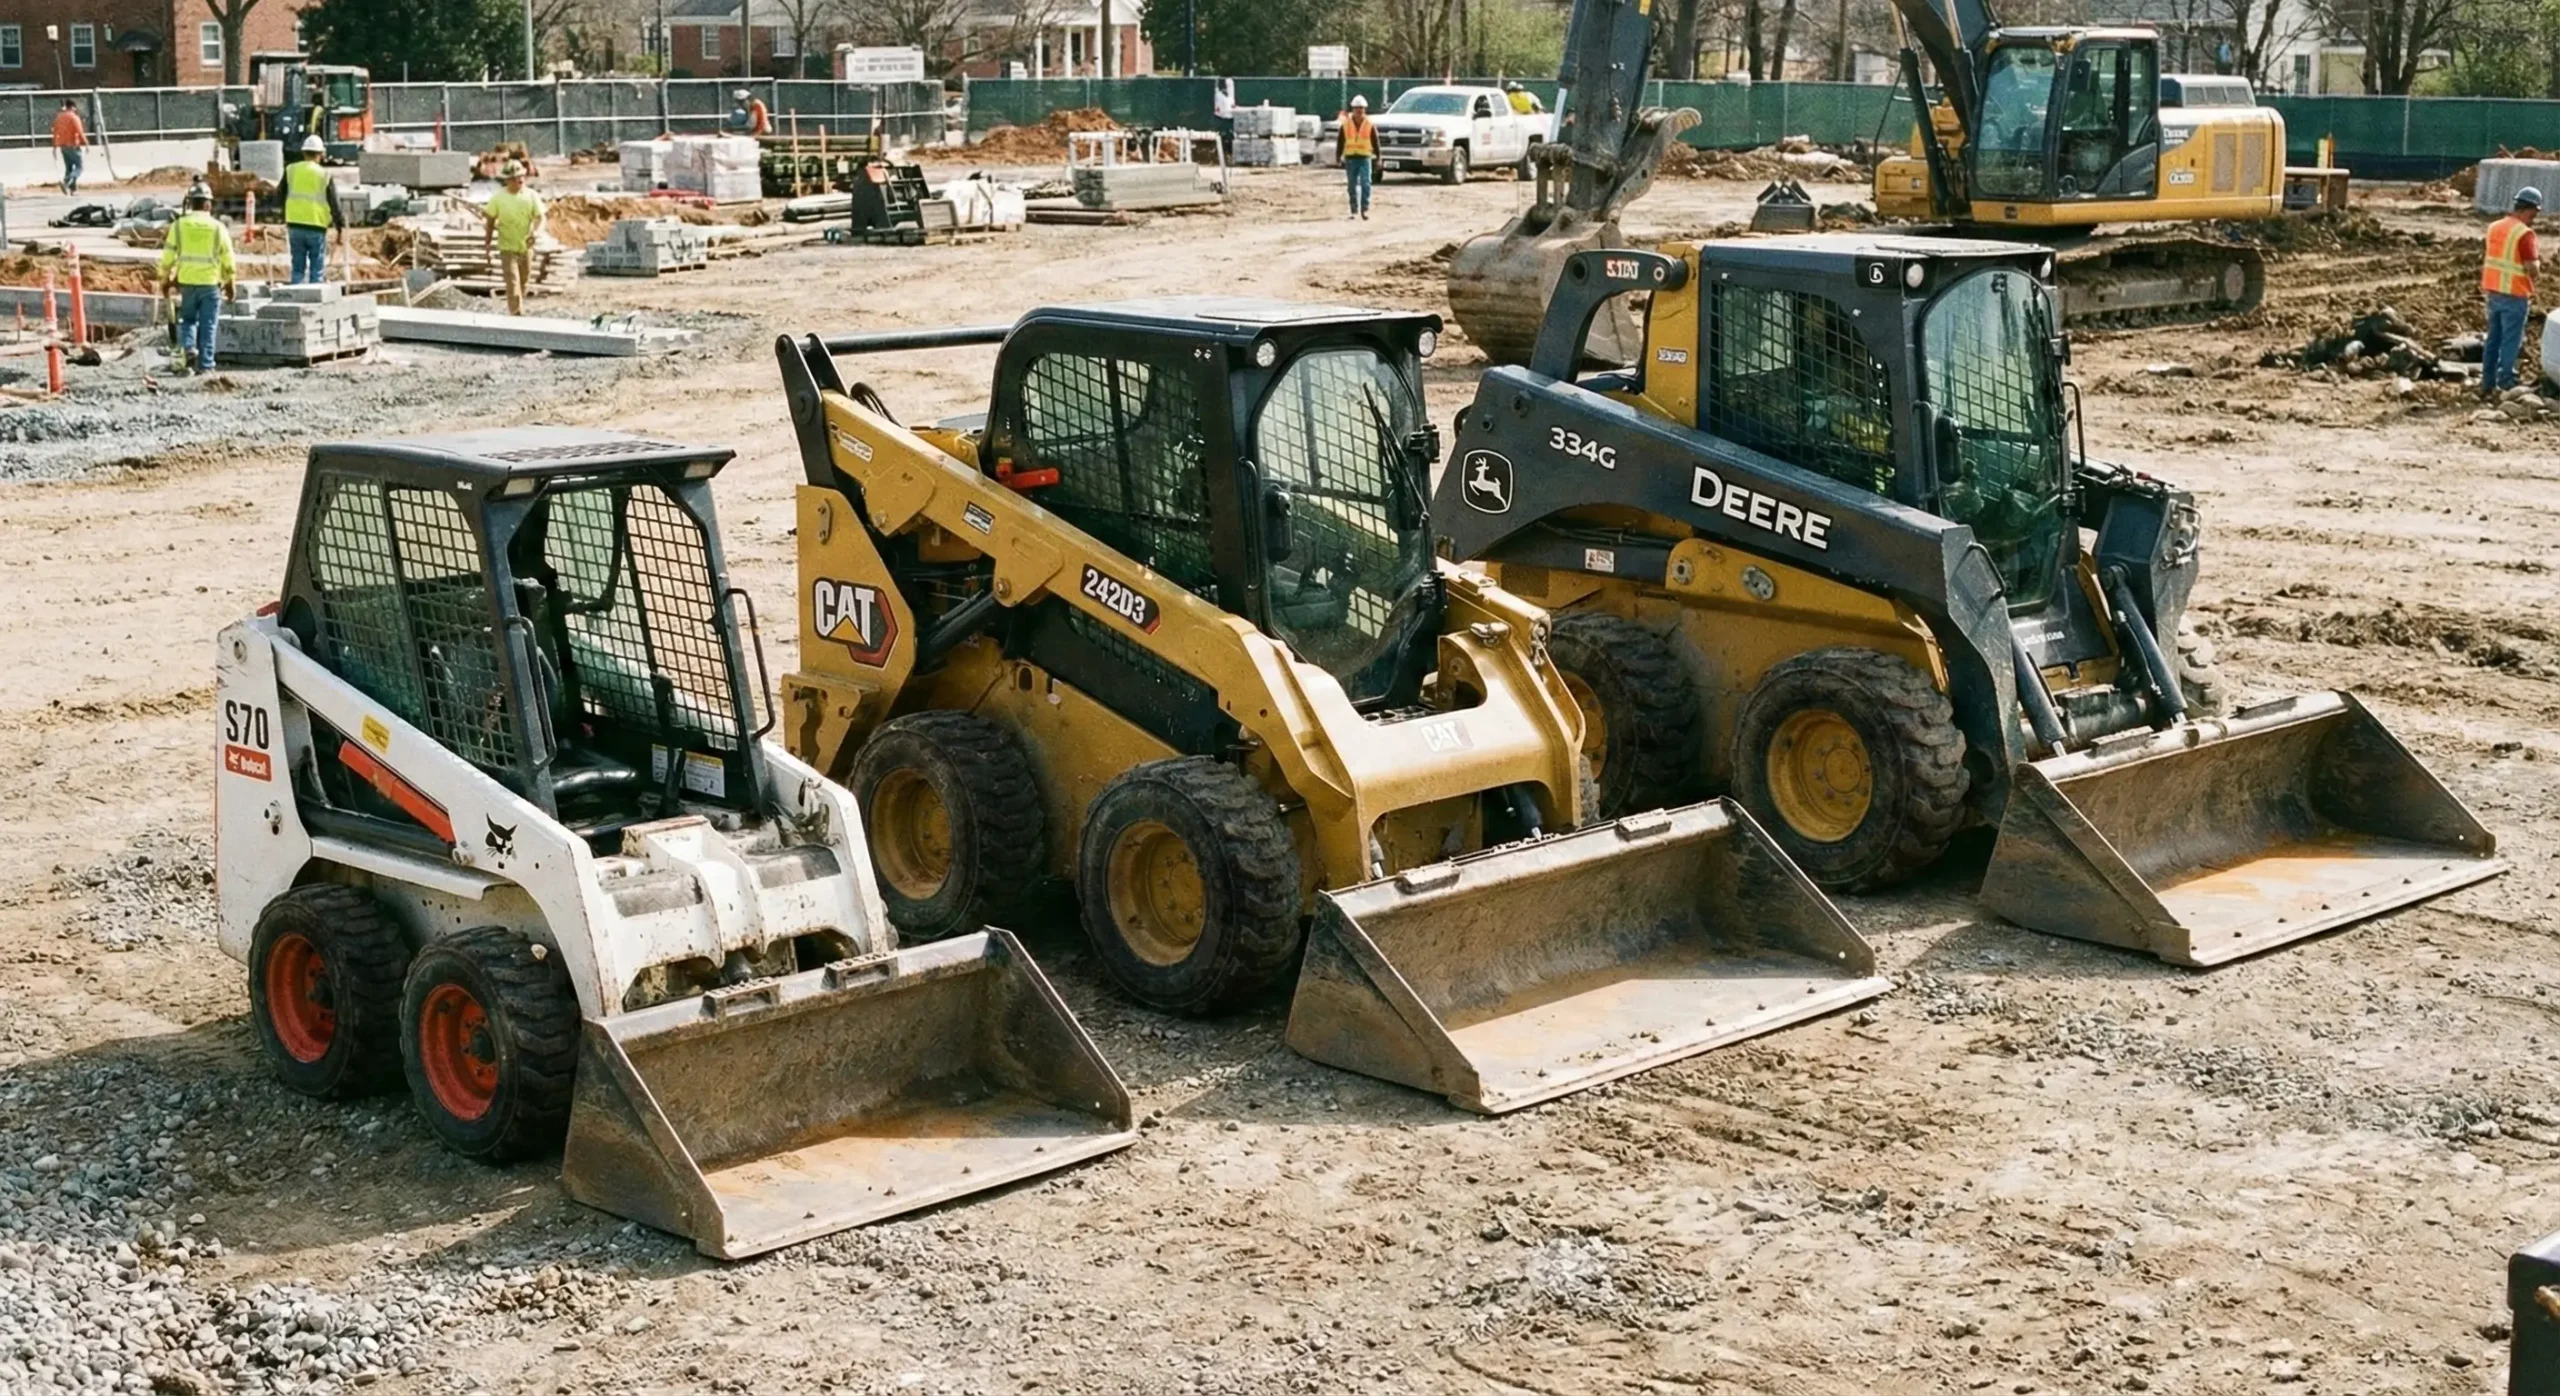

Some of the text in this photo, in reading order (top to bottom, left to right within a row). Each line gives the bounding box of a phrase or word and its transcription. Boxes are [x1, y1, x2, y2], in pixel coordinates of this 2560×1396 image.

[1549, 427, 1616, 469] 334G
[1691, 466, 1831, 549] DEERE
[815, 580, 875, 647] CAT
[1084, 568, 1146, 624] 242D3
[226, 699, 269, 750] S70
[1420, 720, 1463, 752] CAT
